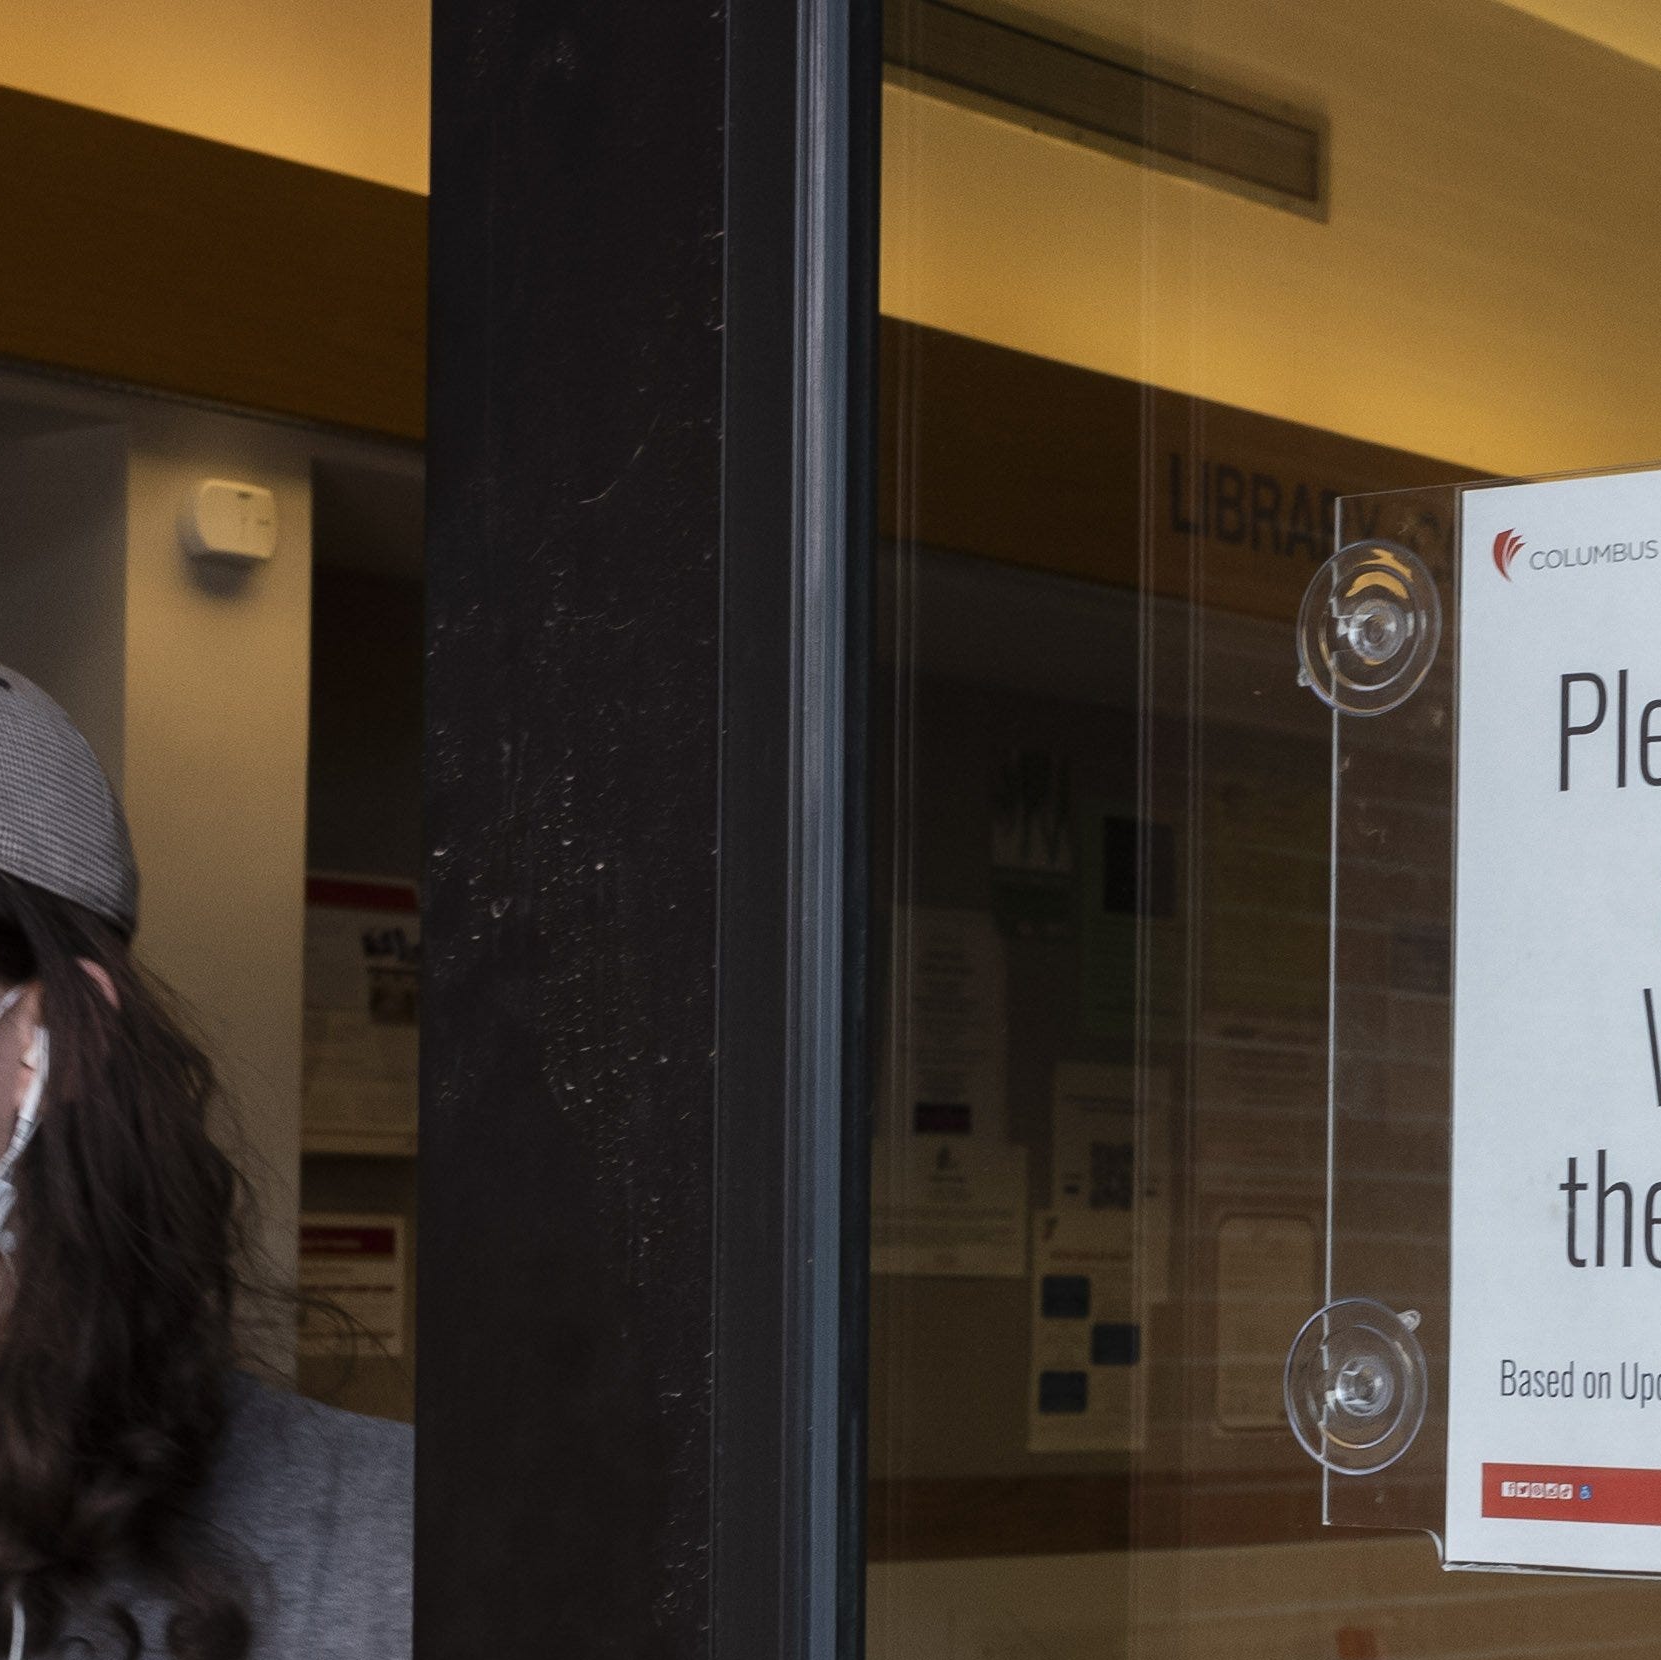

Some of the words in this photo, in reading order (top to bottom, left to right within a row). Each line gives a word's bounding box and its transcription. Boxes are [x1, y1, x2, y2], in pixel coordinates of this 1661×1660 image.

[1529, 539, 1659, 571] COLUMBUS
[1499, 1359, 1575, 1398] Based
[1583, 1371, 1612, 1400] on
